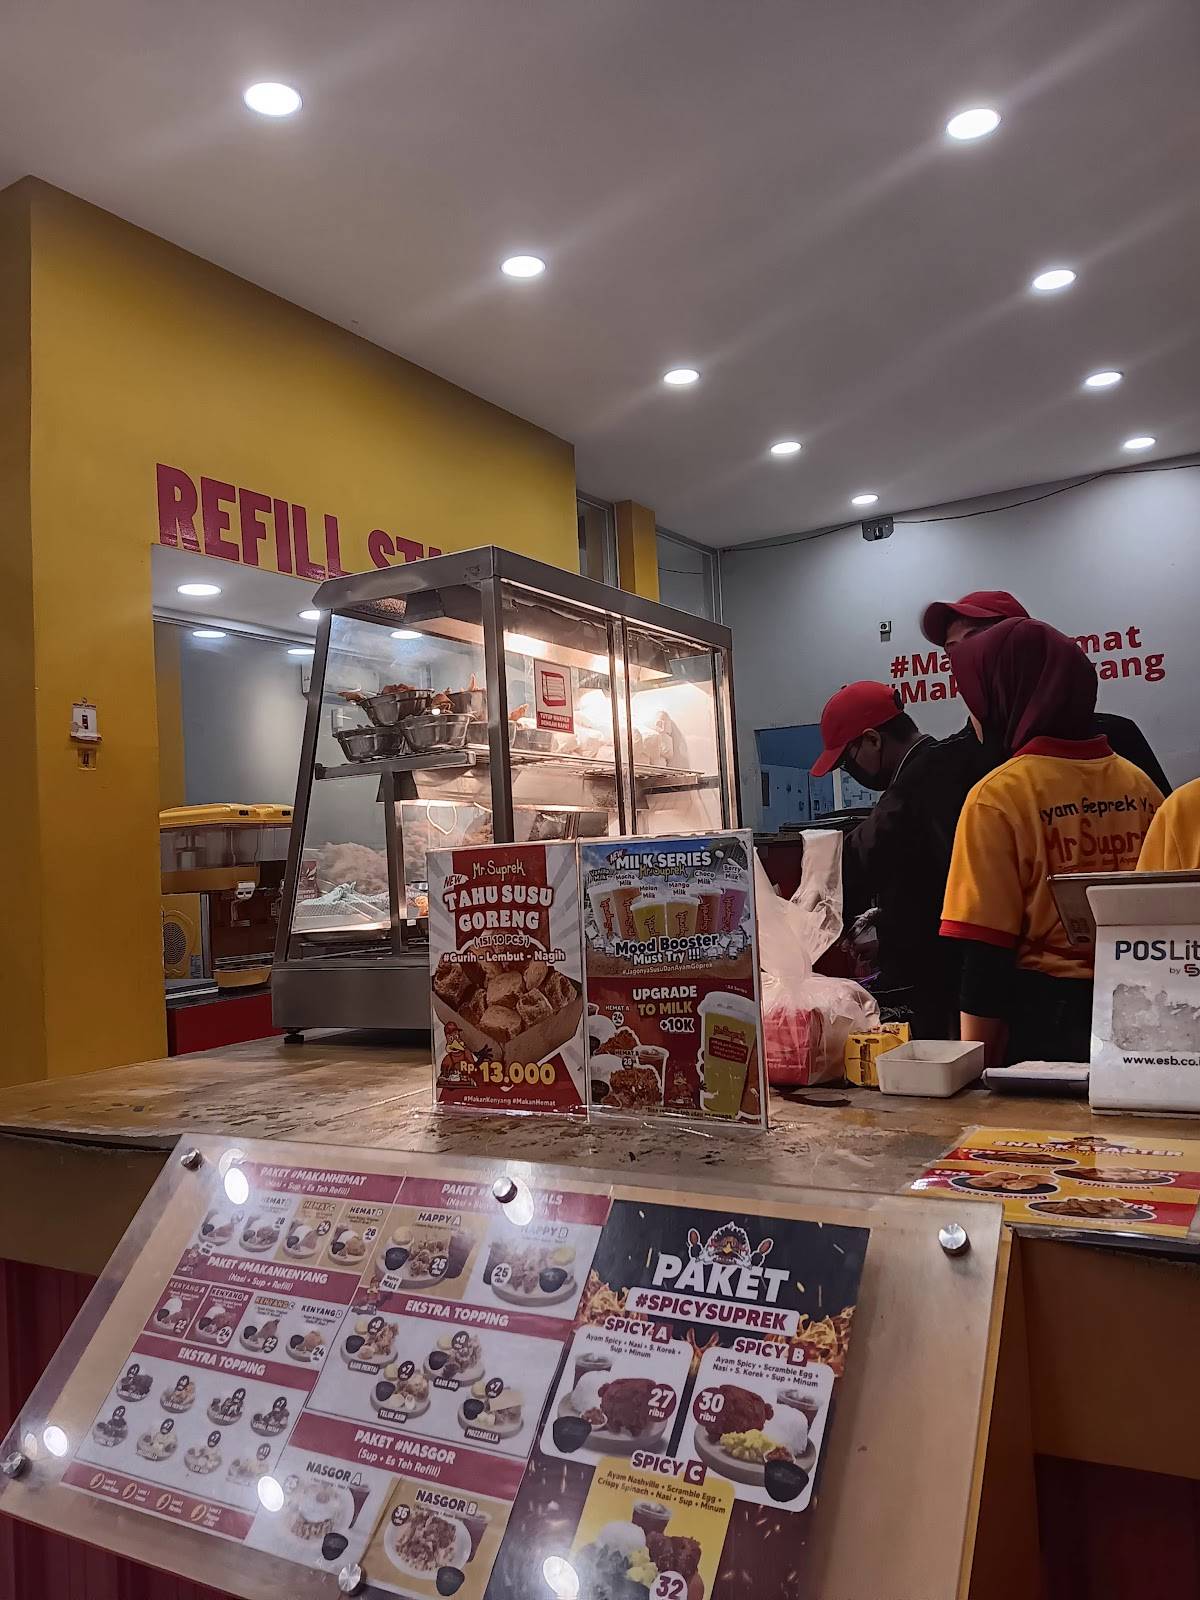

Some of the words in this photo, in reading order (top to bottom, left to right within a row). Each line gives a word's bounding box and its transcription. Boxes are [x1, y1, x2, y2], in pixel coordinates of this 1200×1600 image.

[156, 463, 351, 579] REFILL
[1081, 795, 1137, 817] Geprek
[1080, 818, 1146, 870] Supr
[609, 851, 624, 864] NEW
[617, 855, 652, 870] MILK
[656, 852, 712, 868] SERIES
[444, 874, 462, 888] NEW
[444, 885, 498, 911] TAHU
[502, 885, 552, 907] SUSU
[458, 910, 540, 932] GORENG
[615, 938, 656, 955] Mood
[660, 935, 718, 952] Booster
[443, 952, 477, 962] #Gurih
[486, 952, 524, 962] Lembut
[534, 951, 565, 963] Nagih
[633, 952, 662, 965] Must
[666, 951, 684, 963] Try
[1170, 967, 1181, 975] by
[632, 985, 697, 1001] UPGRADE
[638, 1004, 656, 1016] TO
[659, 1002, 693, 1015] MILK
[660, 1018, 695, 1032] +10K
[479, 1062, 555, 1085] 13.000
[512, 1097, 556, 1106] #MakanHemat
[260, 1167, 289, 1179] PAKET
[441, 1183, 477, 1197] PAKET
[350, 1207, 376, 1215] HEMAT
[417, 1212, 451, 1224] HAPPY
[208, 1256, 236, 1270] PAKET
[238, 1261, 328, 1284] #MAKANKENYANG
[494, 1267, 509, 1278] 25
[652, 1253, 790, 1303] PAKET
[212, 1288, 243, 1300] KENYANG
[301, 1304, 336, 1316] KENYANG
[405, 1300, 450, 1318] EKSTRA
[454, 1307, 510, 1327] TOPPING
[636, 1293, 788, 1331] #SPICYSUPREK
[219, 1328, 231, 1338] 24
[604, 1316, 653, 1337] SPICY
[313, 1347, 324, 1357] 24
[586, 1333, 604, 1343] Ayam
[604, 1335, 623, 1347] Spicy
[628, 1340, 643, 1349] Nasi
[656, 1344, 676, 1355] Korek
[610, 1345, 623, 1355] Sup
[628, 1348, 651, 1358] Minum
[734, 1337, 786, 1359] SPICY
[178, 1347, 217, 1367] EKSTRA
[218, 1355, 265, 1376] TOPPING
[401, 1365, 412, 1374] +7
[715, 1356, 736, 1367] Ayam
[736, 1358, 757, 1370] Spicy
[763, 1364, 797, 1377] Scramble
[798, 1369, 814, 1380] Egg
[712, 1364, 727, 1373] Nasi
[742, 1368, 764, 1378] Korek
[771, 1373, 785, 1383] Sup
[793, 1377, 818, 1388] Minum
[489, 1382, 500, 1391] +7
[648, 1387, 675, 1410] 27
[699, 1392, 725, 1413] 30
[649, 1407, 665, 1418] ribu
[700, 1412, 716, 1423] ribu
[354, 1430, 394, 1450] PAKET
[395, 1440, 456, 1464] #NASGOR
[358, 1448, 378, 1462] (Sup
[398, 1459, 413, 1469] Teh
[632, 1451, 684, 1476] SPICY
[306, 1461, 351, 1481] NASGOR
[597, 1477, 620, 1491] Crispy
[621, 1481, 649, 1496] Spinach
[655, 1490, 672, 1501] Nasi
[678, 1496, 693, 1507] Sup
[700, 1501, 726, 1514] Minum
[607, 1470, 627, 1482] Ayam
[628, 1475, 660, 1490] Nashville
[667, 1484, 701, 1499] Scramble
[702, 1492, 716, 1504] Egg
[416, 1489, 466, 1512] NASGOR
[656, 1575, 684, 1600] 32
